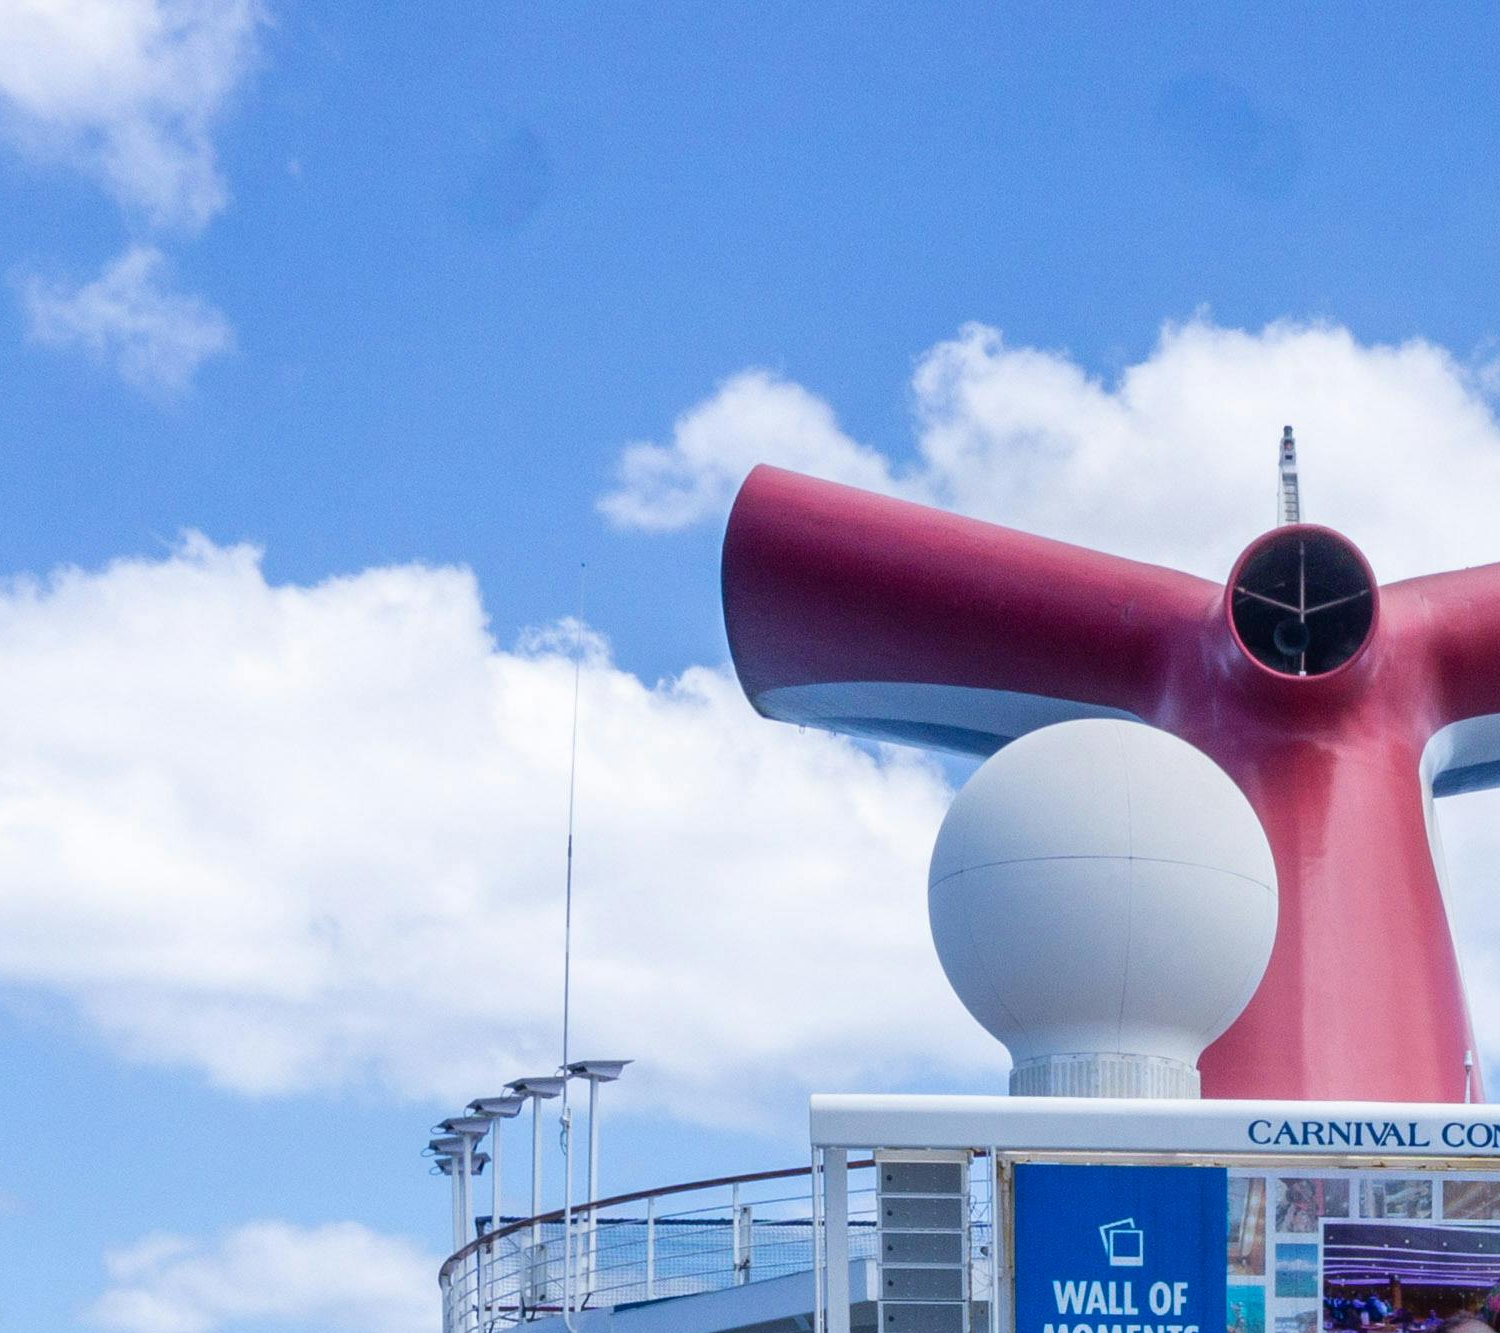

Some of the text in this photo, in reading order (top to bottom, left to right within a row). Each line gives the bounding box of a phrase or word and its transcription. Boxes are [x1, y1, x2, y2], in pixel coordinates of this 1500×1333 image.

[1248, 1120, 1430, 1146] CARNIVAL
[1052, 1280, 1188, 1316] WALL OF
